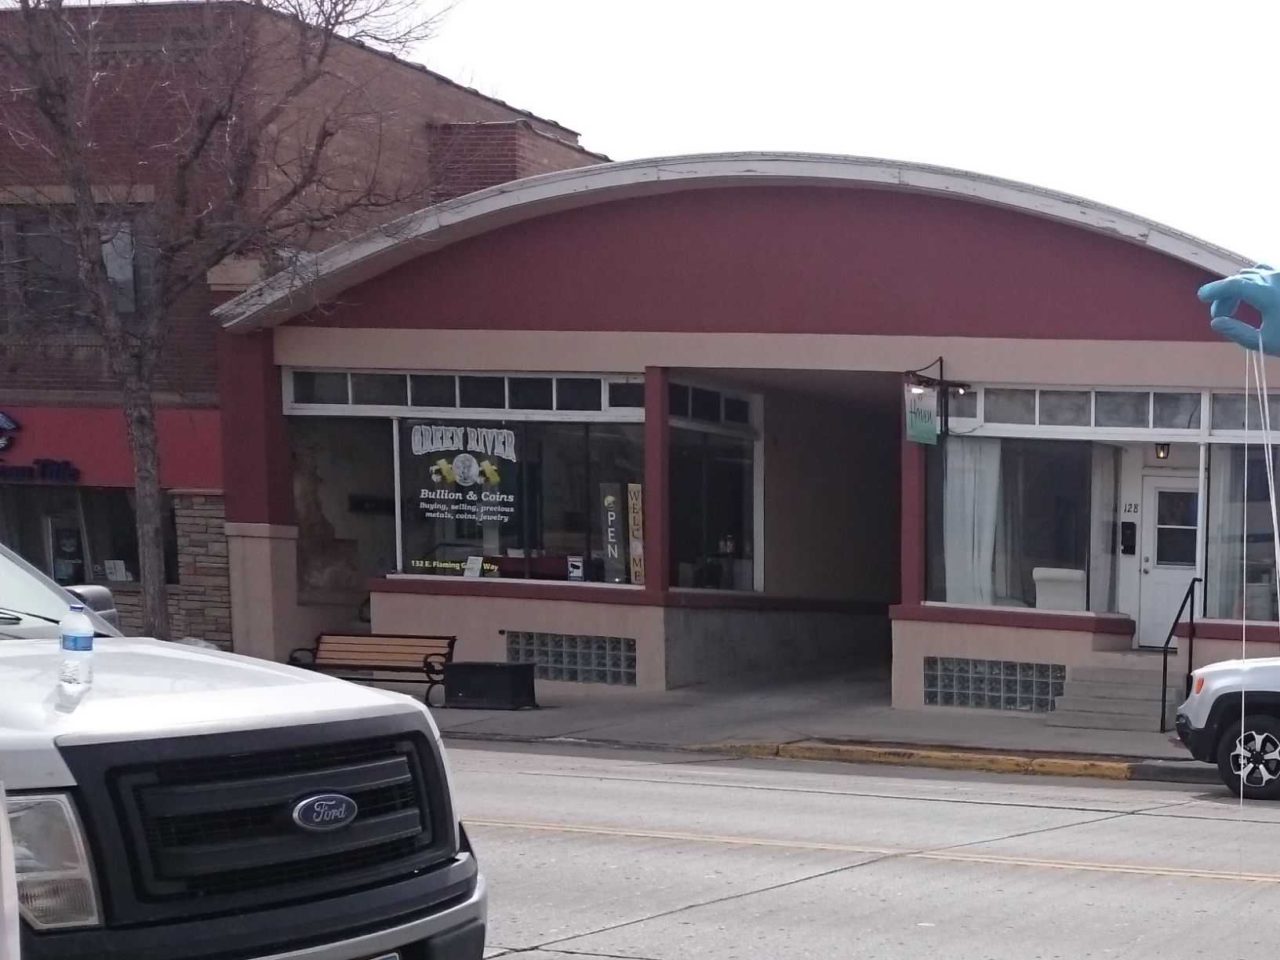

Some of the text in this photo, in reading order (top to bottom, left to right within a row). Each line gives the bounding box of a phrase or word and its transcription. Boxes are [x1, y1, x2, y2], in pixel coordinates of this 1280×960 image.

[412, 425, 516, 462] GREEN RIVER
[420, 489, 515, 502] Bullion & Coins
[419, 502, 449, 511] Buying,
[451, 504, 479, 512] selling,
[479, 513, 509, 522] jewelry
[433, 561, 460, 570] Flaming
[483, 563, 498, 572] Way
[313, 800, 346, 822] Ford
